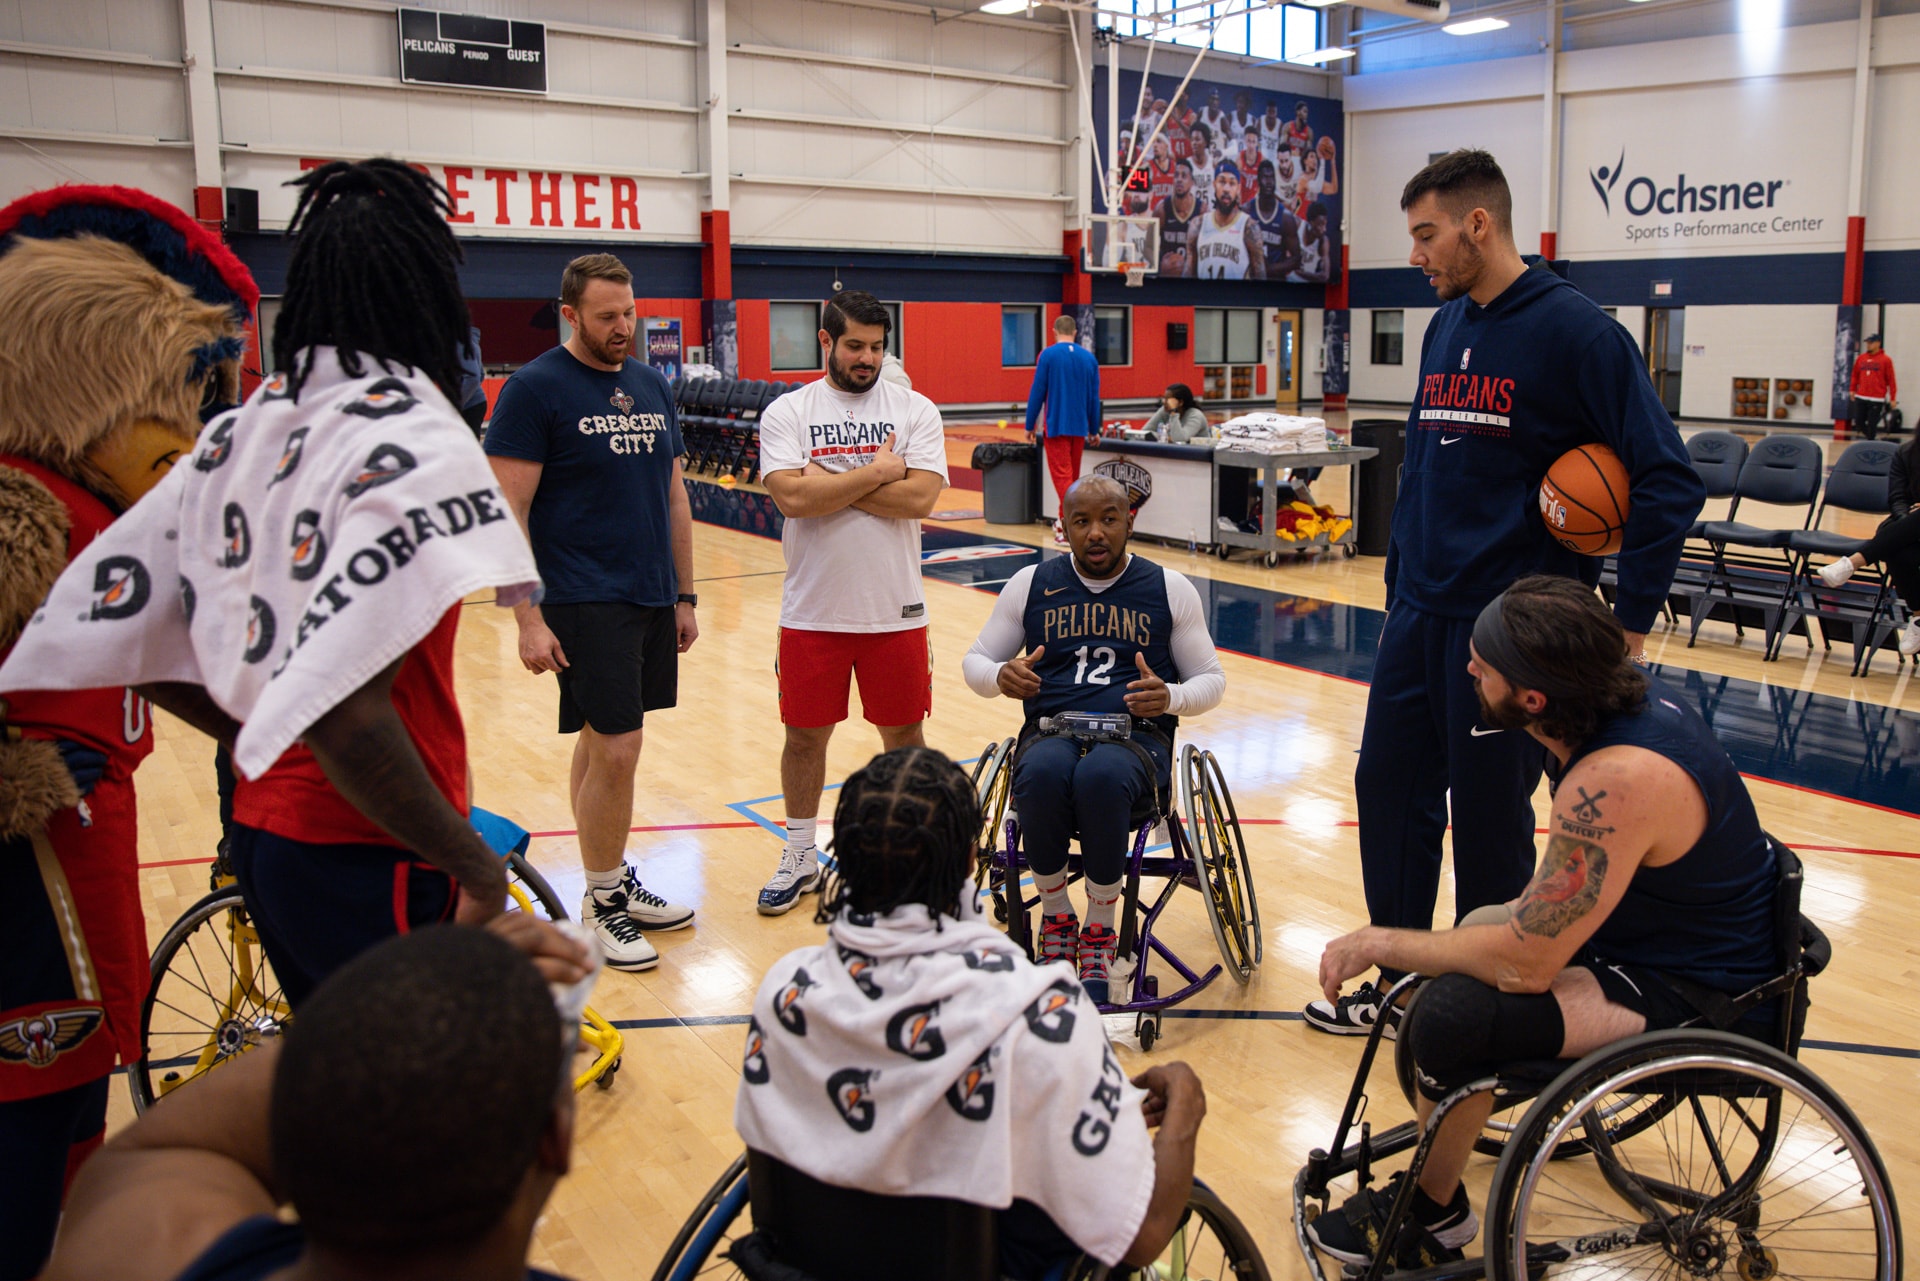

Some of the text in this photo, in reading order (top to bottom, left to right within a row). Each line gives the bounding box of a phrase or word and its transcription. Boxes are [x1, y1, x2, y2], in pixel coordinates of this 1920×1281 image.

[403, 38, 541, 62] PELICANS PERIOD GUEST
[1128, 168, 1148, 190] 24
[1624, 173, 1783, 217] Ochsner
[1625, 215, 1825, 243] Sports Performance Center
[1212, 241, 1240, 265] ORLEANS
[1421, 373, 1516, 414] PELICANS
[578, 412, 667, 436] CRESCENT
[609, 432, 656, 455] CITY
[1114, 464, 1152, 491] ORLEANS
[1043, 602, 1151, 647] PELICANS
[1074, 645, 1116, 686] 12
[1561, 821, 1605, 841] DUTCHY
[1072, 1022, 1122, 1157] GAT
[1574, 1231, 1632, 1254] Eagle
